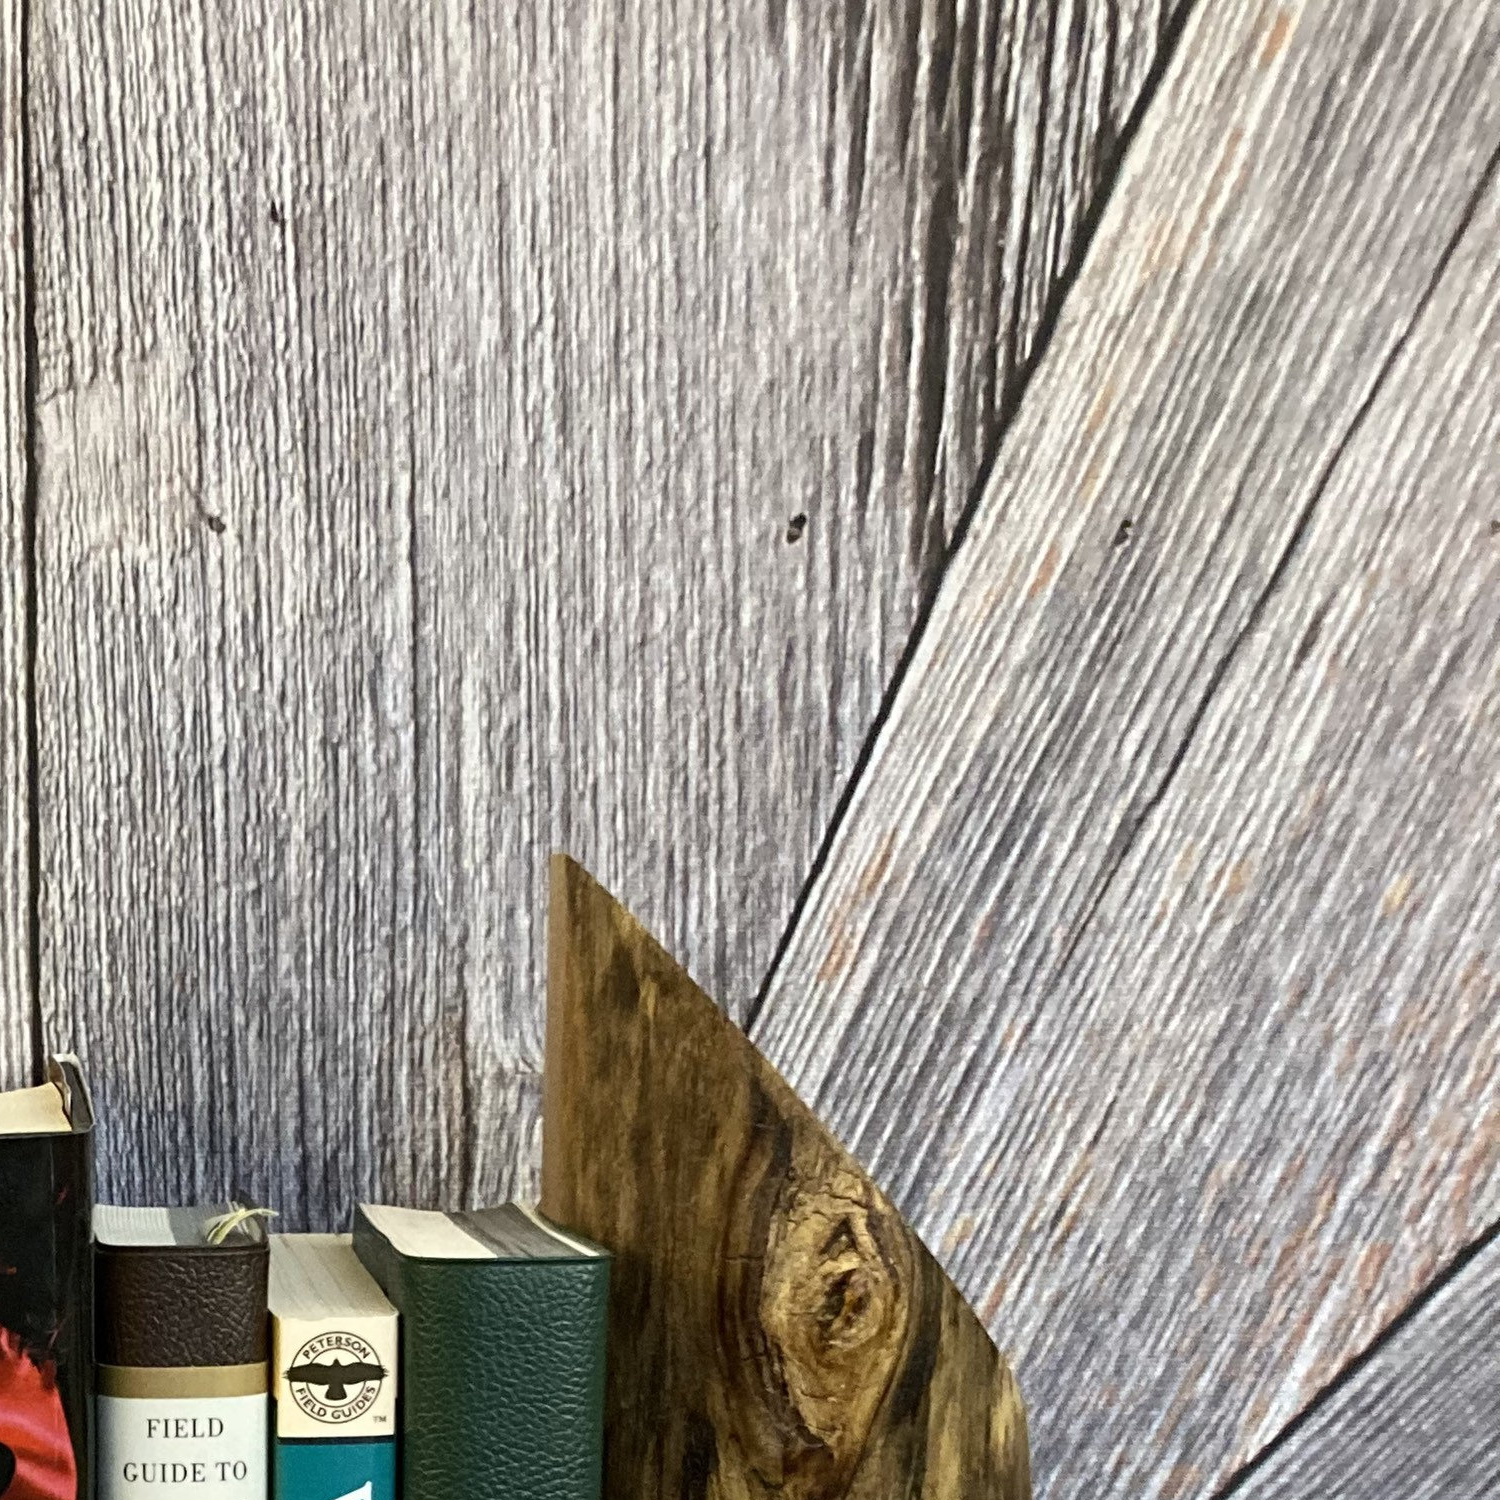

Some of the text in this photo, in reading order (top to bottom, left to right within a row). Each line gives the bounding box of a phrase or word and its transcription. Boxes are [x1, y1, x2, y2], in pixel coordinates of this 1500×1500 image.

[302, 1335, 371, 1360] PETERSON
[296, 1386, 376, 1420] FIELD GUIDES
[146, 1417, 224, 1438] FIELD
[123, 1460, 248, 1483] GUIDE TO
